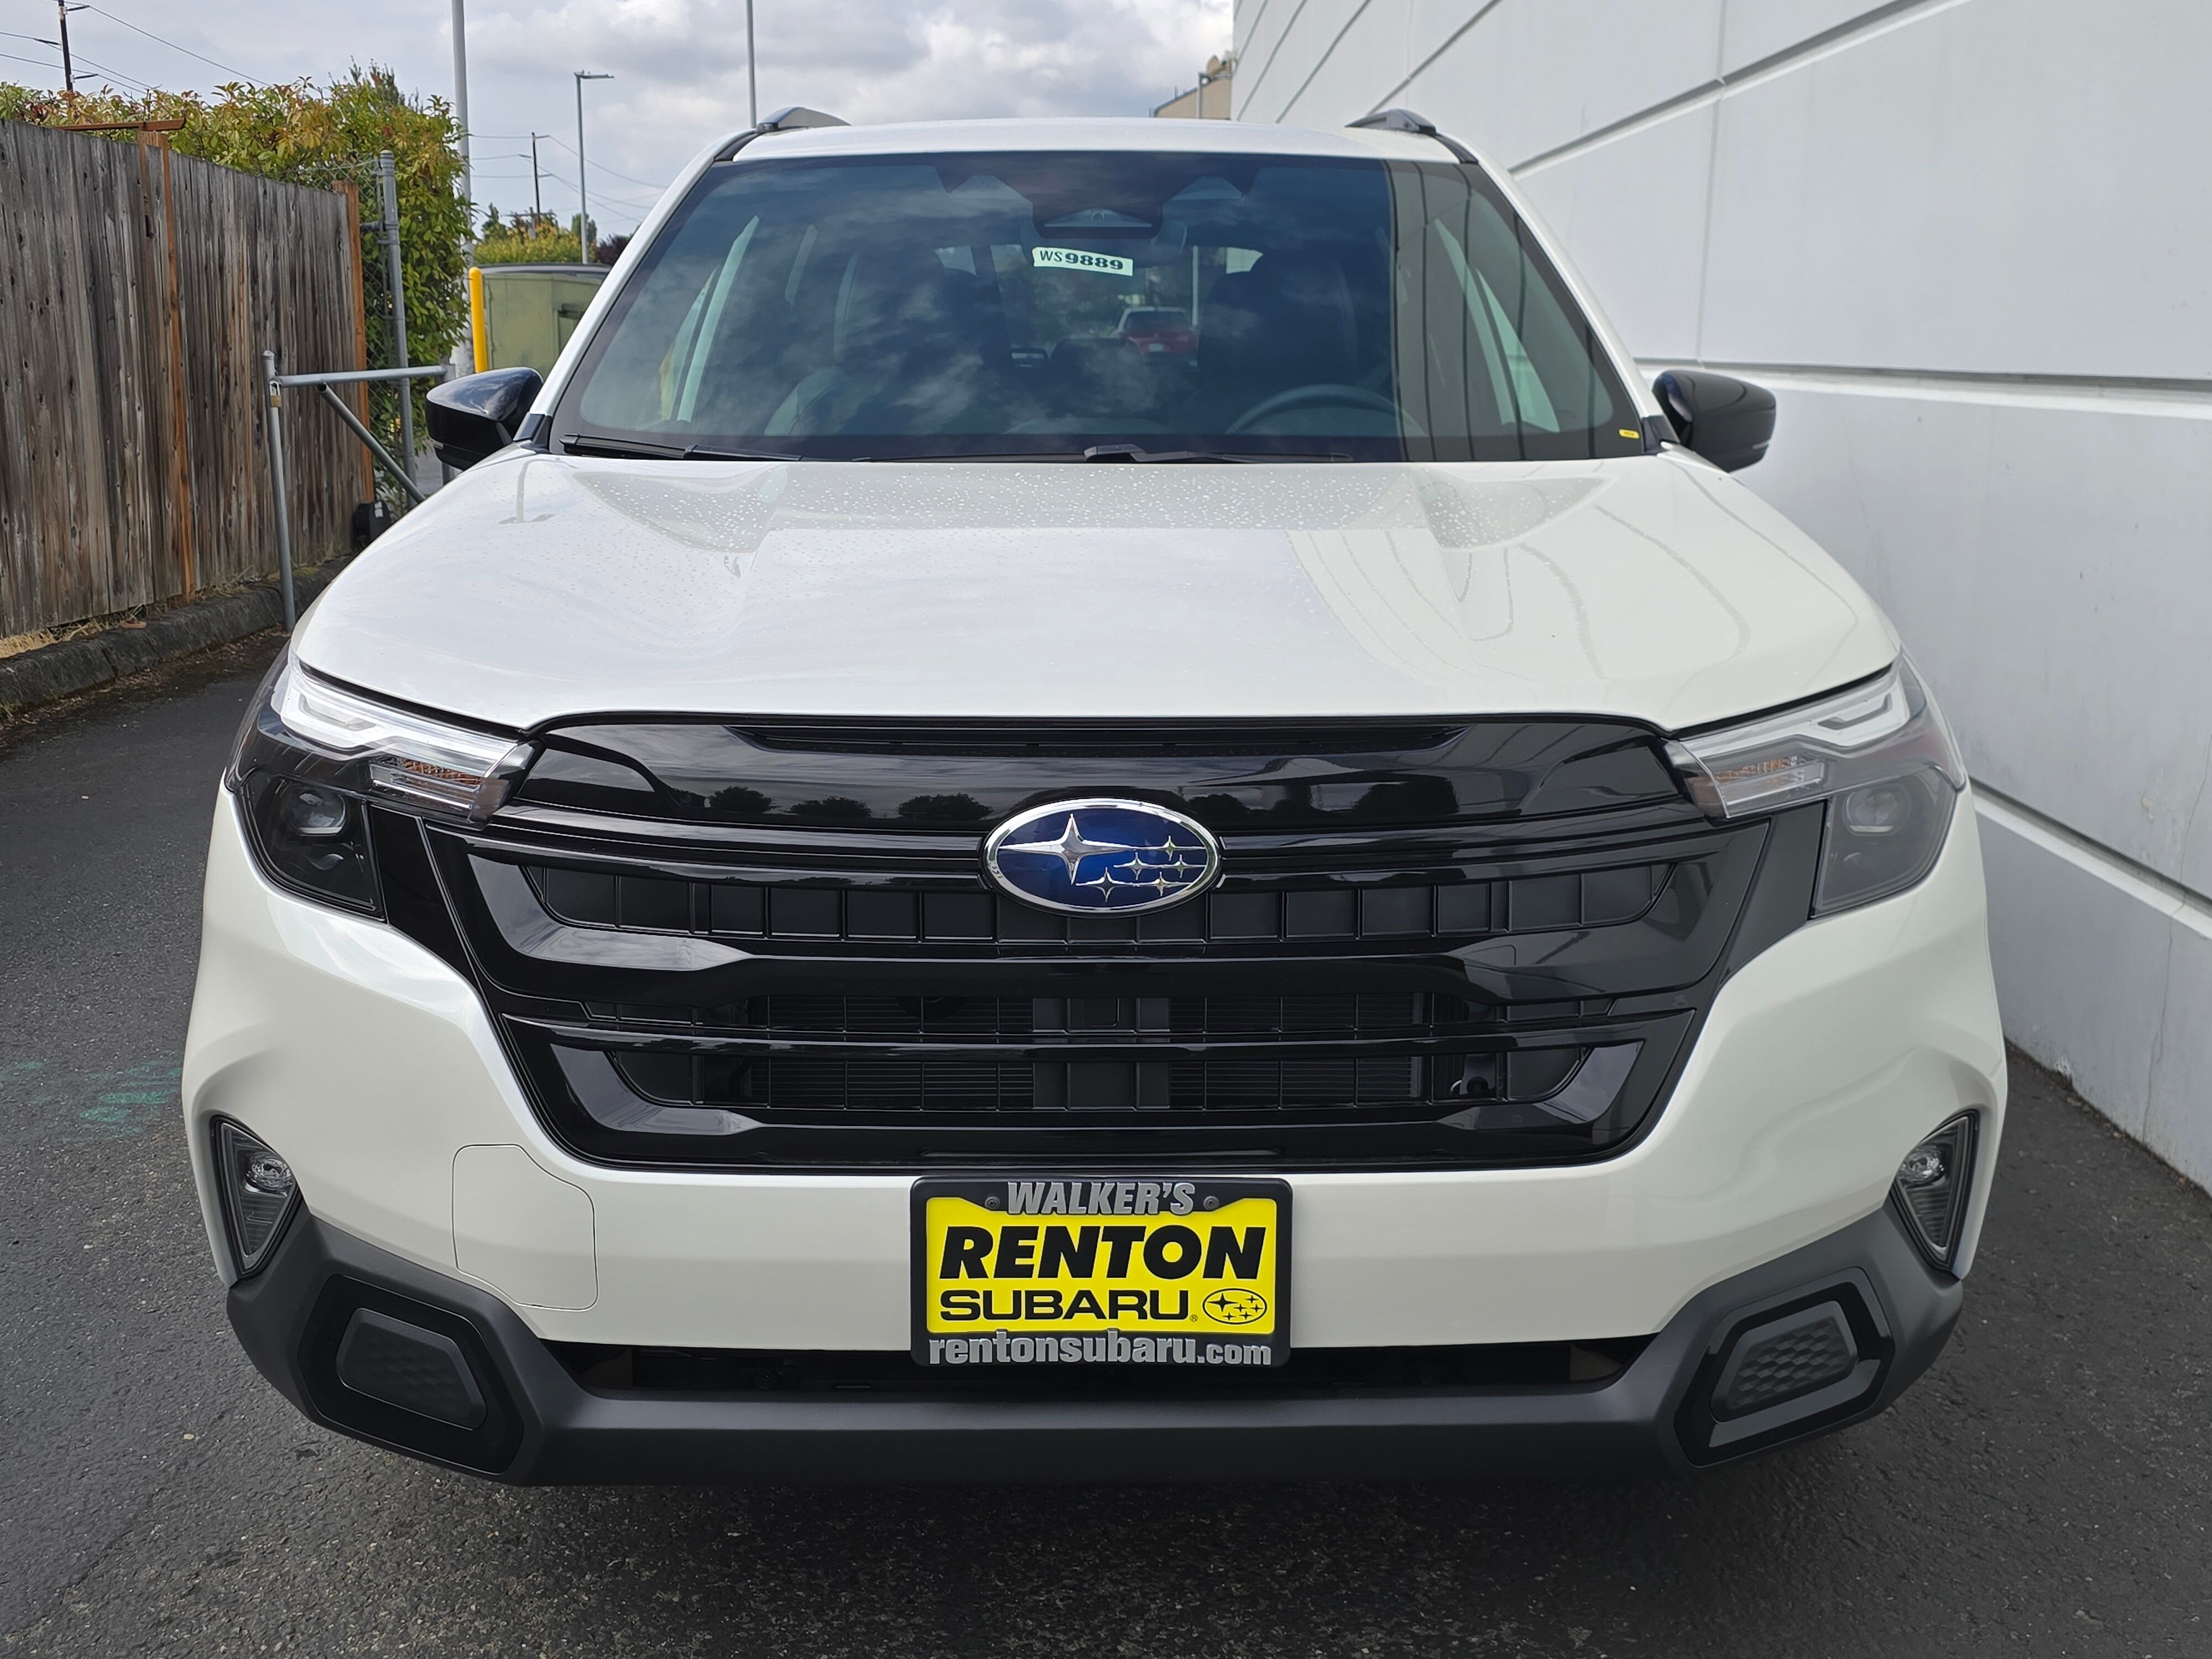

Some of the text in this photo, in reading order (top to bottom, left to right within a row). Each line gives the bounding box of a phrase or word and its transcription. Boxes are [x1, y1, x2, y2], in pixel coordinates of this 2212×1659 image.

[1040, 250, 1123, 270] WS9889
[1008, 1181, 1196, 1215] WALKER'S
[940, 1224, 1266, 1280] RENTON
[929, 1329, 1272, 1366] rentonsubaru.com
